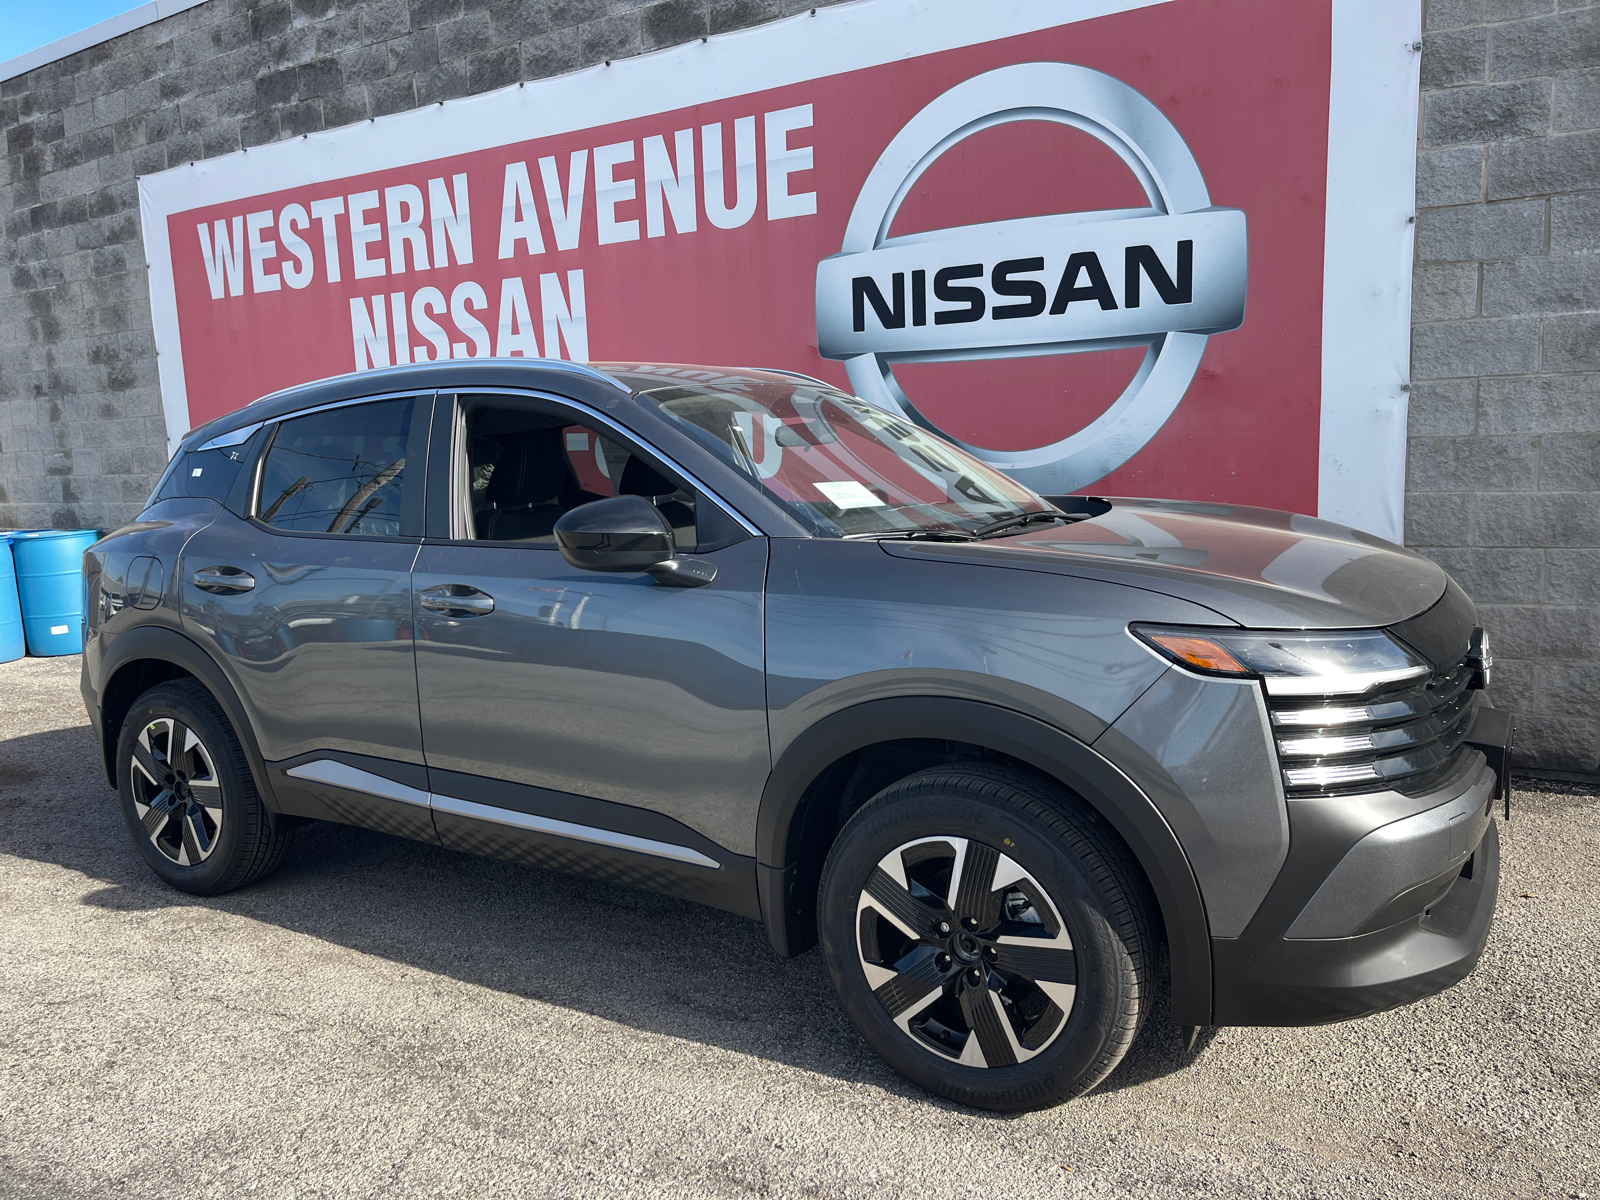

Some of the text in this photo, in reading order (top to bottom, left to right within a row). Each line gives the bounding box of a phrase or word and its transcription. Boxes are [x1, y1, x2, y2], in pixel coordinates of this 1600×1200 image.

[197, 103, 817, 300] WESTERN AVENUE
[349, 269, 589, 372] NISSAN
[852, 240, 1193, 332] NISSAN
